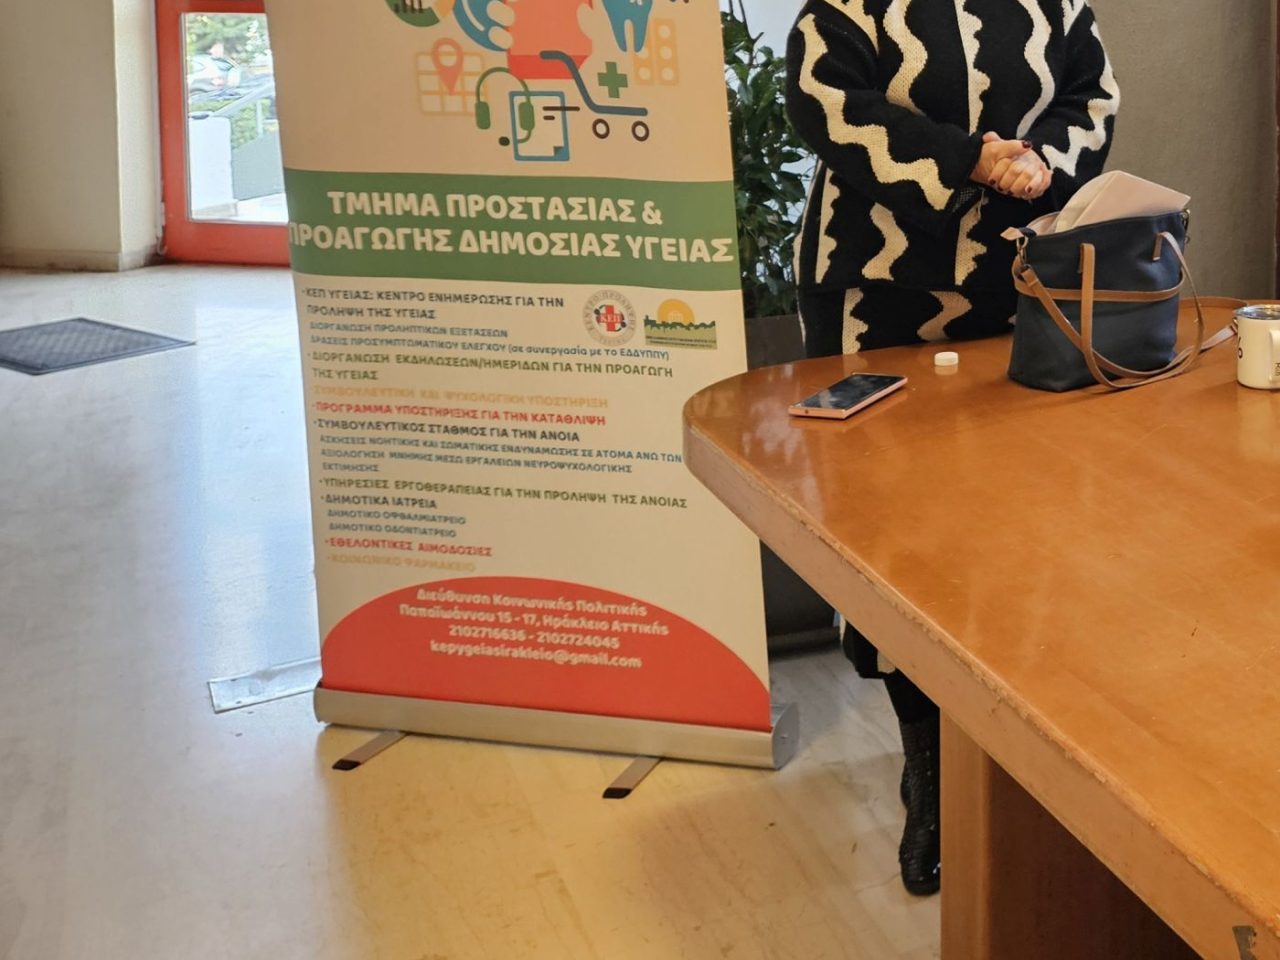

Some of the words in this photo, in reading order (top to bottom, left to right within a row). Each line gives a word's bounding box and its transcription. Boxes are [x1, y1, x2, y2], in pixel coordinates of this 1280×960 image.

[327, 191, 440, 217] ΤΜΗΜΑ
[446, 193, 636, 223] ΠΡΟΣΤΑΣΙΑΣ
[642, 201, 663, 225] &
[288, 221, 453, 252] ΠΡΟΑΓΩΓΗΣ
[459, 229, 621, 258] ΔΗΜΟΣΙΑΣ
[625, 234, 734, 263] ΥΓΕΙΑΣ
[376, 291, 425, 302] ΚΕΝΤΡΟ
[428, 292, 512, 306] ΕΝΗΜΕΡΩΣΗΣ
[515, 296, 535, 307] ΓΙΑ
[537, 297, 564, 307] ΤΗΝ
[306, 305, 364, 317] ΠΡΟΛΗΨΗ
[367, 308, 392, 318] ΤΗΣ
[394, 308, 436, 319] ΥΓΕΙΑΣ
[604, 349, 617, 357] το
[312, 368, 332, 379] ΤΗΣ
[336, 370, 379, 381] ΥΓΕΙΑΣ
[553, 362, 573, 372] ΓΙΑ
[576, 363, 602, 373] ΤΗΝ
[605, 364, 673, 377] ΠΡΟΑΓΩΓΗ
[316, 401, 392, 414] ΠΡΟΓΡΑΜΜΑ
[395, 406, 479, 419] ΥΠΟΣΤΗΡΙΞΗΣ
[481, 410, 499, 420] ΓΙΑ
[503, 411, 528, 422] ΤΗΝ
[531, 413, 606, 426] ΚΑΤΑΘΛΙΨΗ
[318, 419, 425, 433] ΣΥΜΒΟΥΛΕΥΤΙΚΟΣ
[428, 424, 487, 437] ΣΤΑΘΜΟΣ
[490, 428, 509, 438] ΓΙΑ
[511, 429, 537, 439] ΤΗΝ
[540, 431, 580, 442] ΑΝΟΙΑ
[596, 450, 634, 460] ΑΤΟΜΑ
[636, 451, 658, 461] ΑΝΩ
[661, 453, 682, 463] ΤΩΝ
[323, 478, 390, 489] ΥΠΗΡΕΣΙΕΣ
[394, 480, 491, 496] ΕΡΓΟΘΕΡΑΠΕΙΑΣ
[494, 487, 512, 498] ΓΙΑ
[515, 488, 541, 499] ΤΗΝ
[544, 490, 606, 503] ΠΡΟΛΗΨΗ
[612, 494, 637, 505] ΤΗΣ
[640, 496, 687, 509] ΑΝΟΙΑΣ
[325, 494, 389, 506] ΔΗΜΟΤΙΚΑ
[392, 497, 437, 509] ΙΑΤΡΕΙΑ
[416, 587, 491, 605] Διεύθυνση
[493, 594, 574, 611] Κοινωνικής
[575, 599, 648, 617] Πολιτικής
[497, 611, 512, 623] 15
[542, 613, 609, 631] Ηράκλειο
[611, 620, 669, 635] Αττικής
